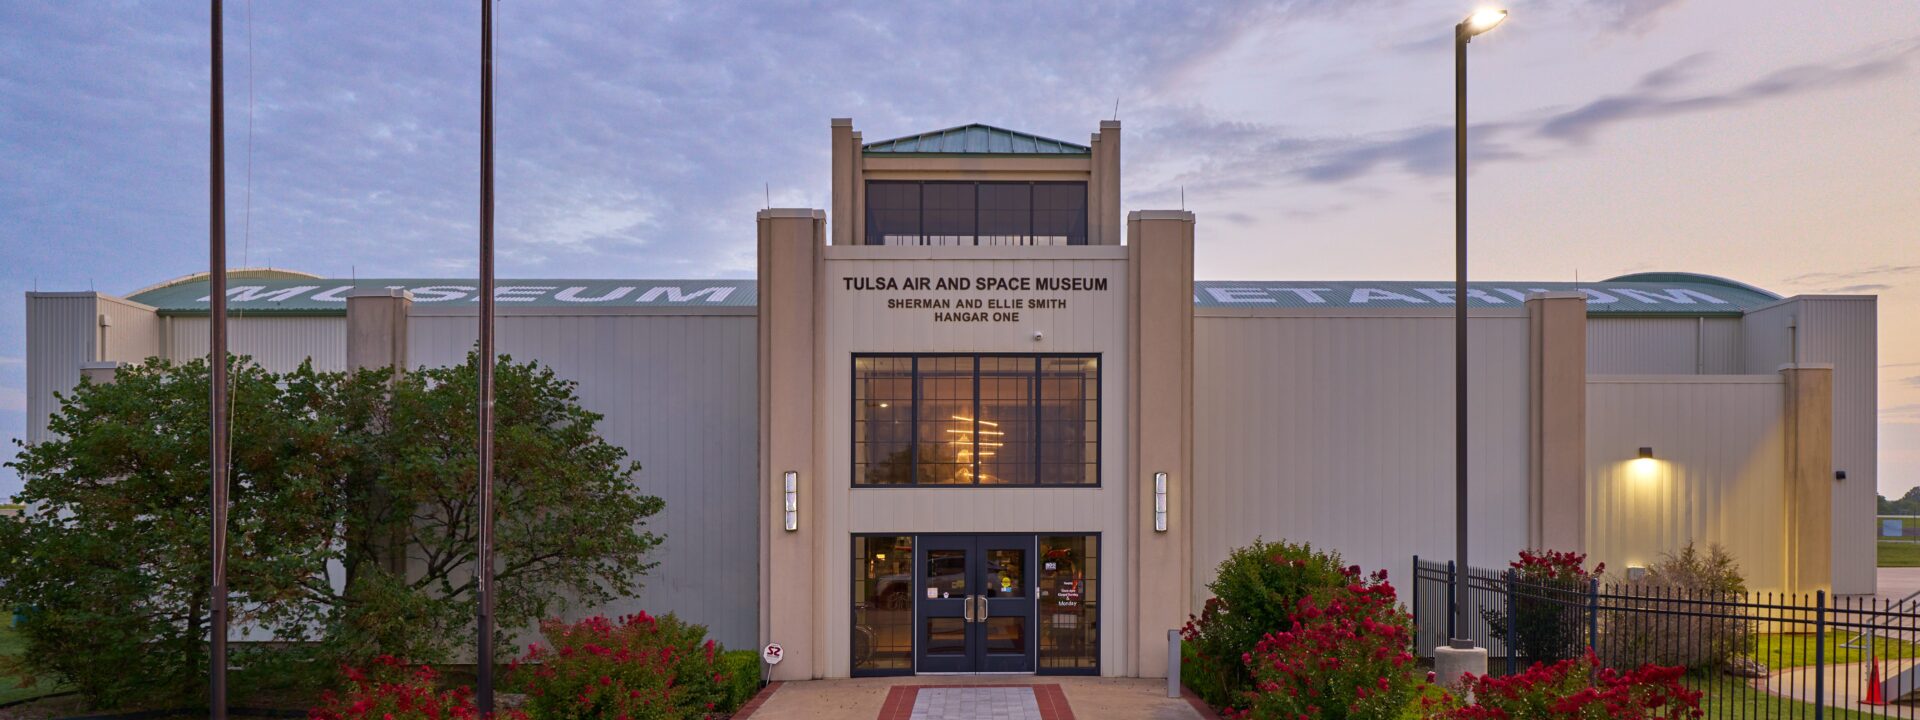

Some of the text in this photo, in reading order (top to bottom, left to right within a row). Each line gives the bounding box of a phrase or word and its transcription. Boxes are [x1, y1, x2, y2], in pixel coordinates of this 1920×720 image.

[842, 276, 1108, 292] TULSA AIR AND SPACE MUSEUM
[887, 298, 1067, 309] SHERMAN AND ELLIE SMITH
[934, 311, 1020, 322] HANGAR ONE
